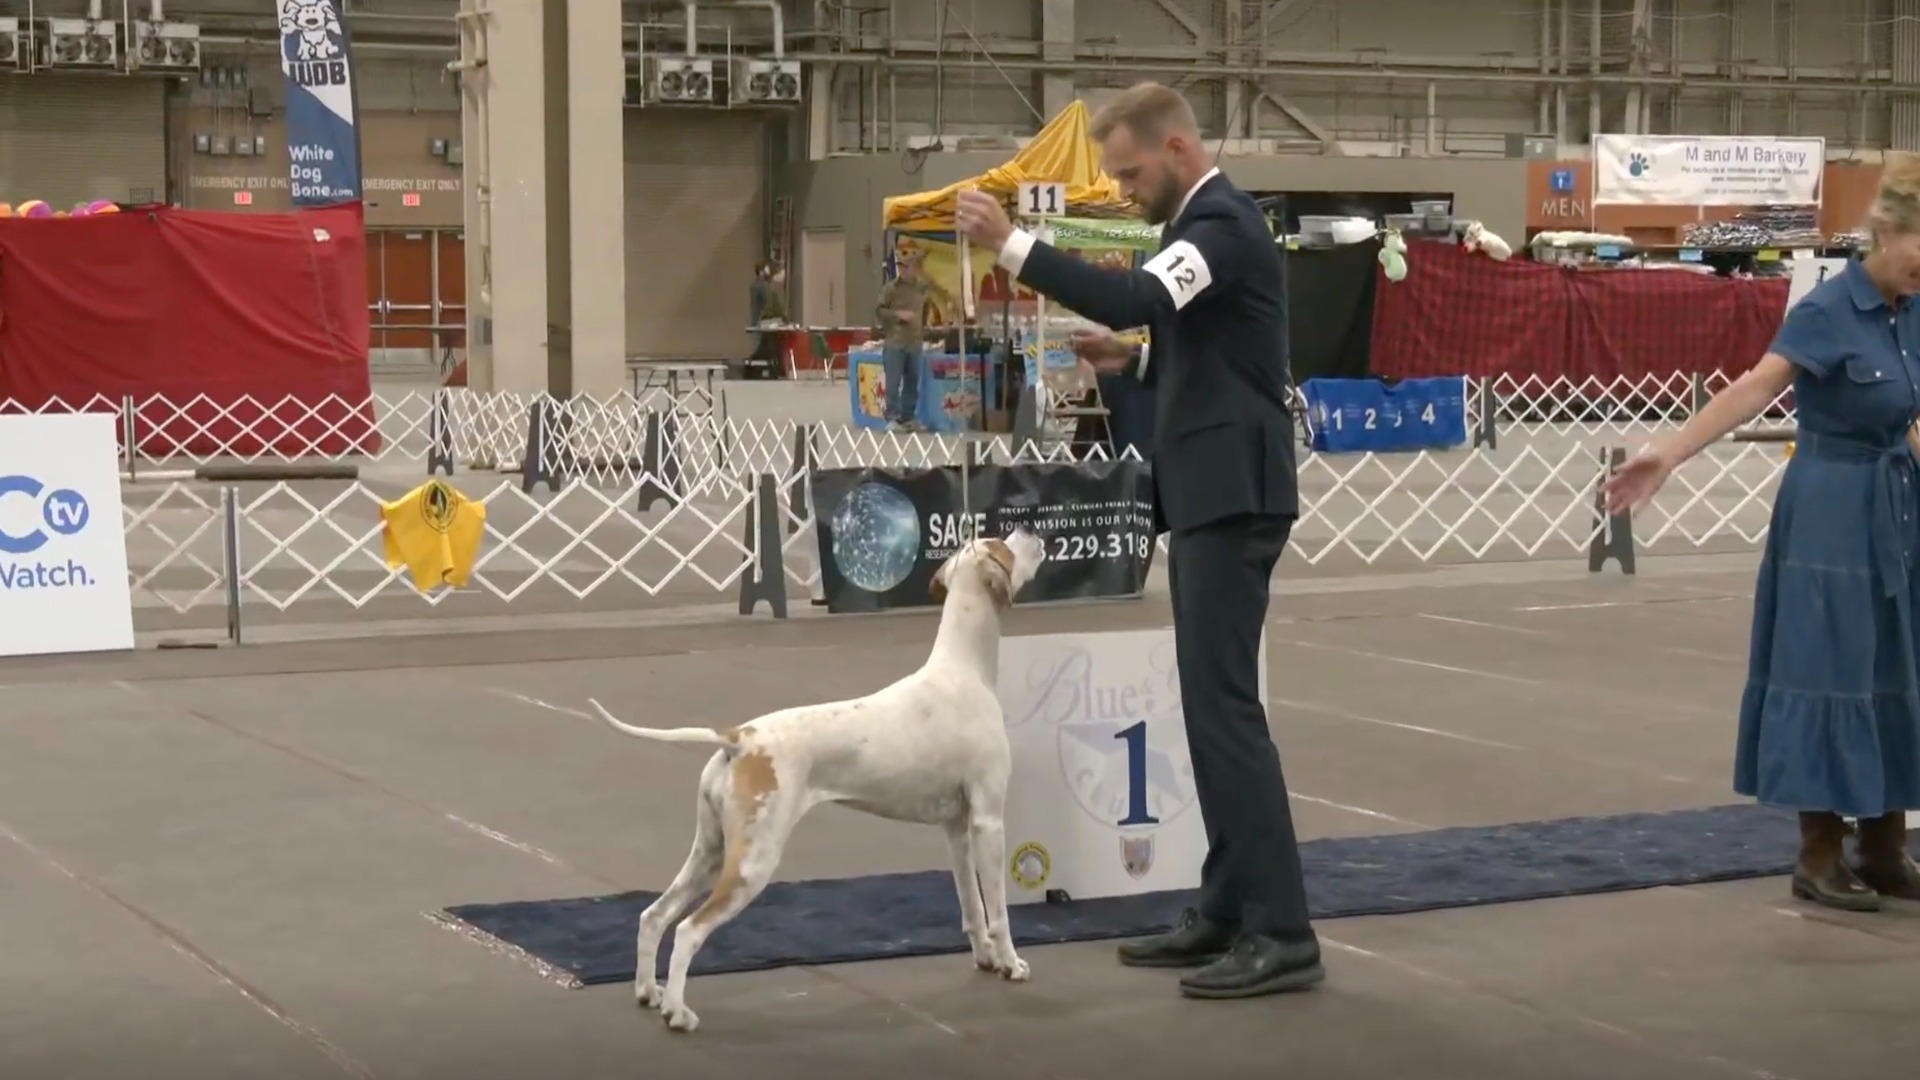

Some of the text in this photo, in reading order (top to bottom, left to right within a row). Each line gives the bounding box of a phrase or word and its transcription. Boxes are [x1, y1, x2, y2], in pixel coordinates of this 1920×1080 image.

[289, 144, 334, 161] White
[1686, 147, 1806, 168] M and M Barkery
[190, 177, 289, 189] EMERGENCY EXIT ONL
[291, 164, 321, 183] Dog
[292, 181, 354, 197] Bone.com
[362, 178, 460, 191] EMERGENCY EXIT ONLY
[1029, 184, 1058, 213] 11
[1541, 198, 1585, 217] MEN
[1166, 253, 1197, 292] 12
[1332, 407, 1343, 431] 1
[1364, 407, 1377, 430] 2
[1421, 402, 1436, 426] 4
[48, 496, 85, 527] tv
[1034, 518, 1077, 530] VISION
[1082, 516, 1092, 528] IS
[1096, 515, 1120, 527] OUR
[1113, 719, 1160, 827] 1
